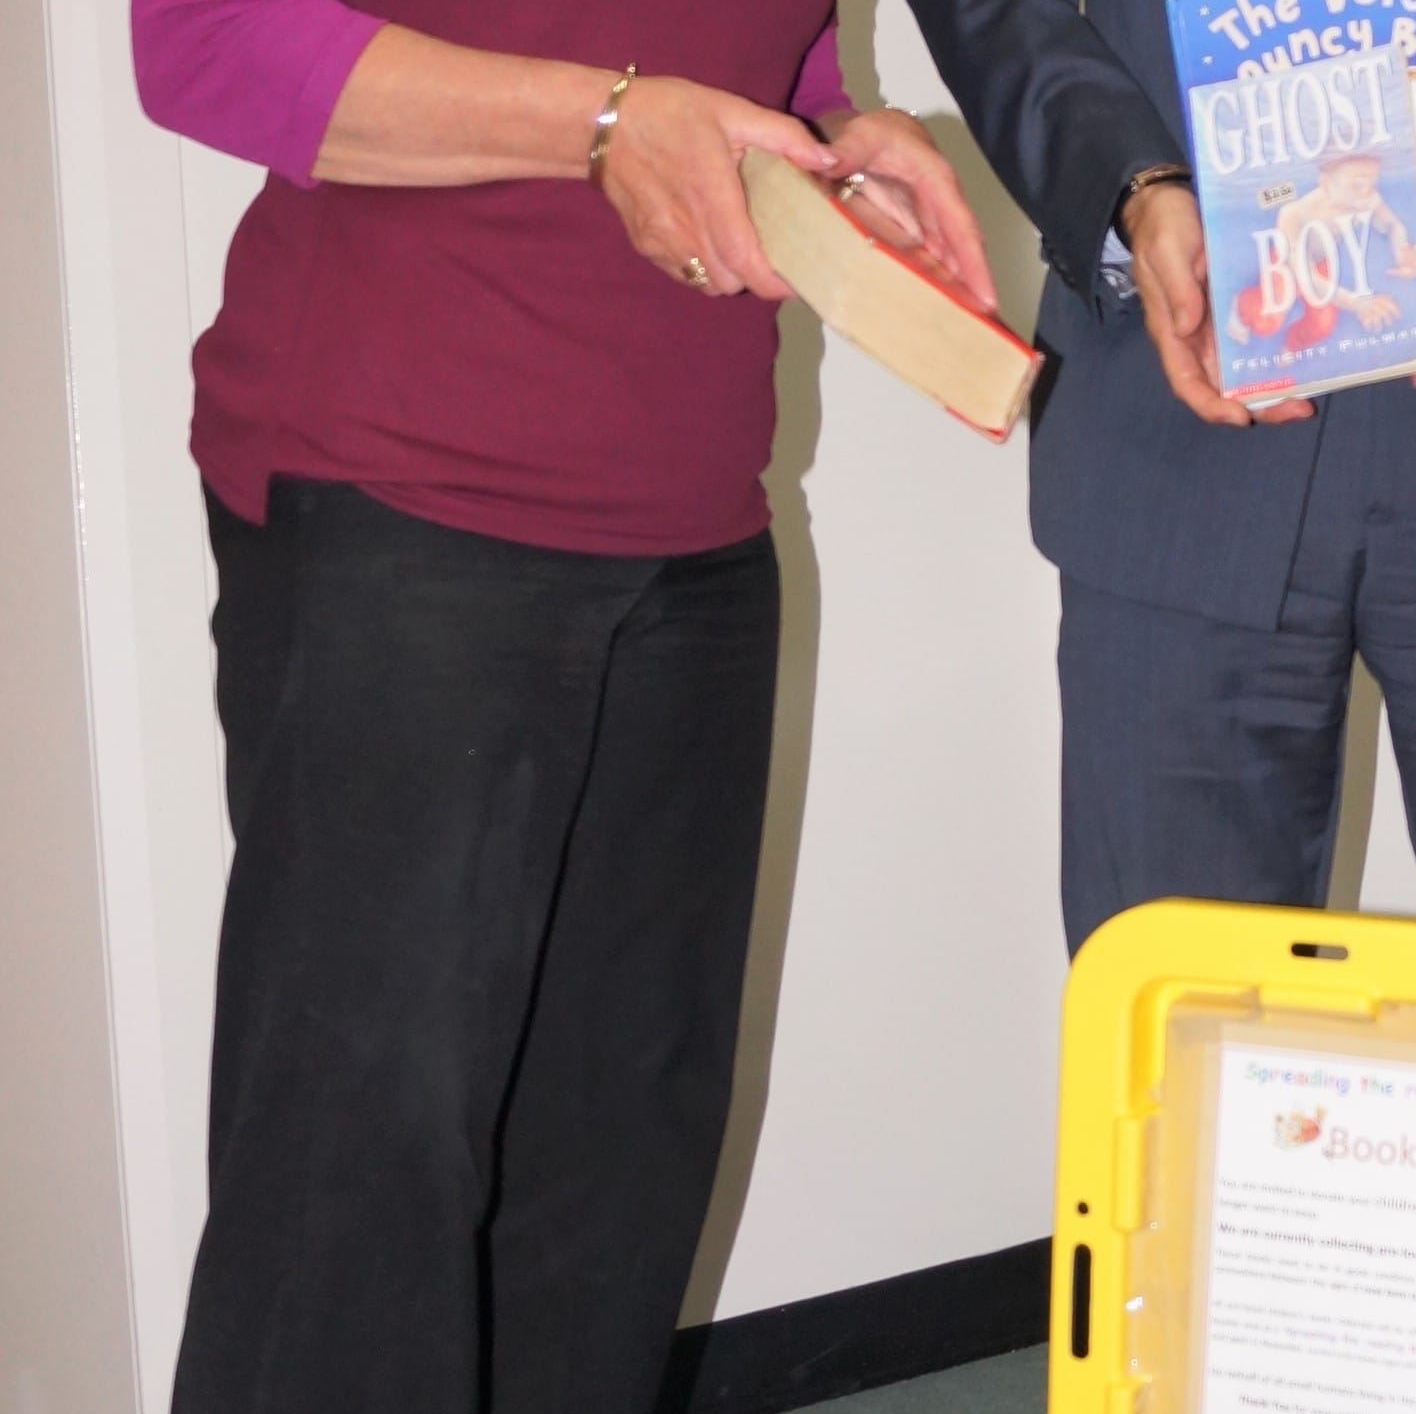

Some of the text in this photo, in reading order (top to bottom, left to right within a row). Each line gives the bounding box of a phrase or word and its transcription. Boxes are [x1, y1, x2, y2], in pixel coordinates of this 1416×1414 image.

[1237, 18, 1374, 81] ouncy
[1206, 53, 1395, 176] GHOST
[1251, 211, 1376, 316] BOY
[1246, 1063, 1350, 1096] Spreading
[1361, 1075, 1394, 1095] the
[1329, 1125, 1416, 1168] Book
